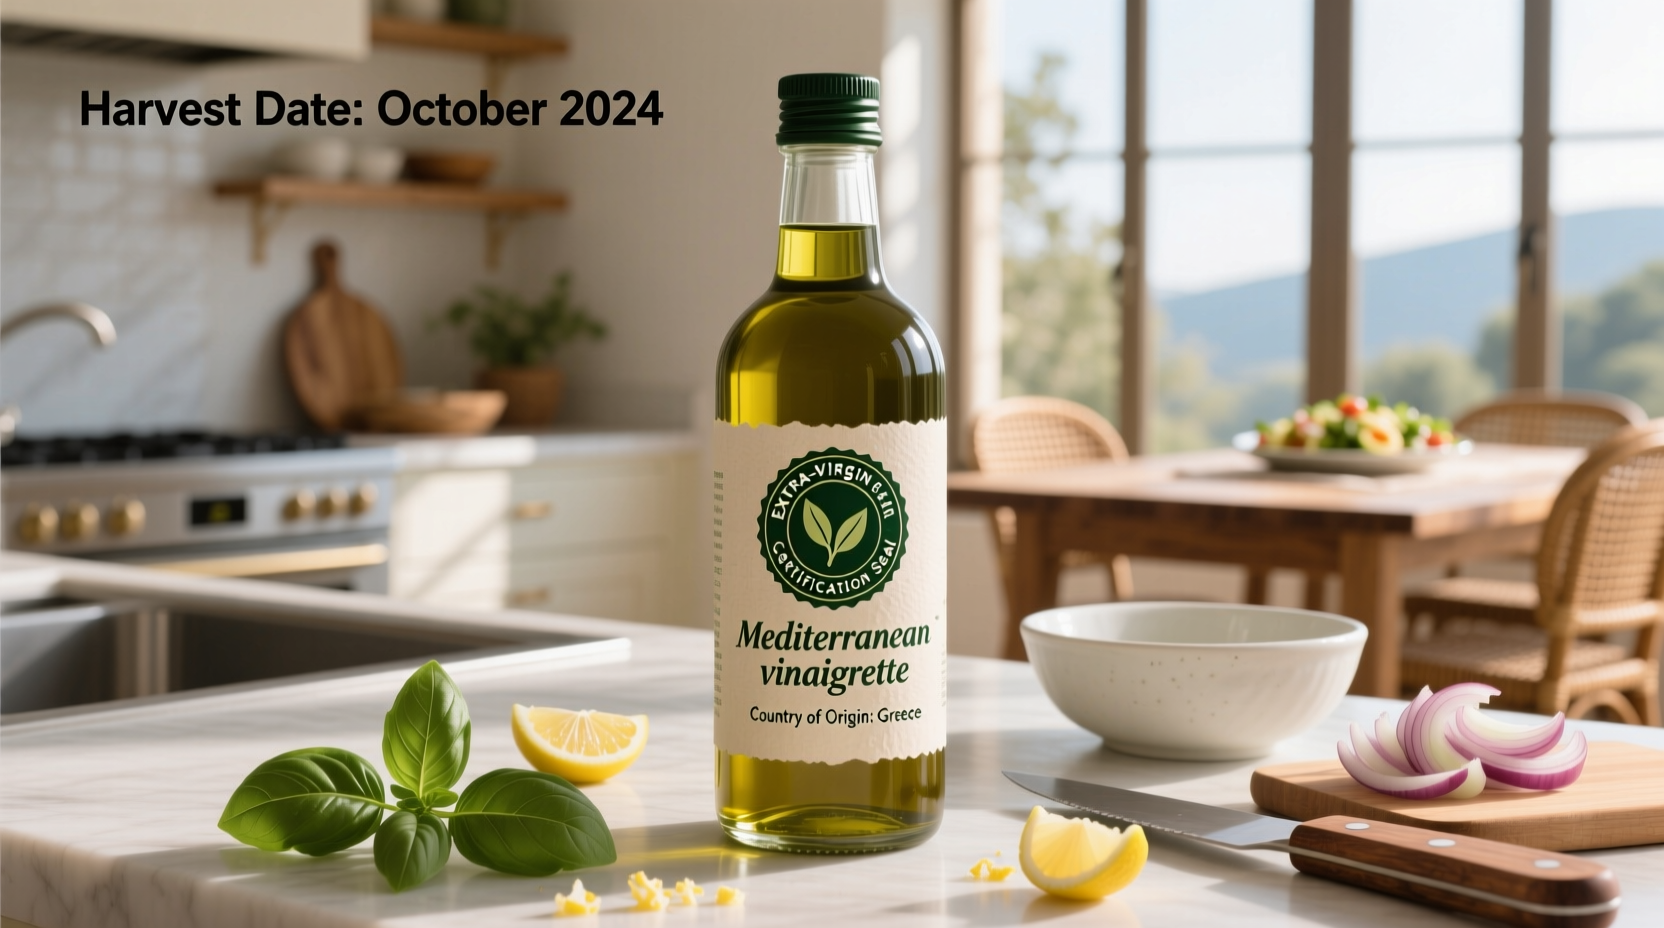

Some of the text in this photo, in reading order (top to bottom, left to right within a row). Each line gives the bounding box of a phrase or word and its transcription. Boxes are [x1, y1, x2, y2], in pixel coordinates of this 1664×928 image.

[735, 619, 932, 652] Mediterranean
[760, 657, 910, 697] vinaigrette
[749, 705, 922, 729] Country of Origin: Greece
